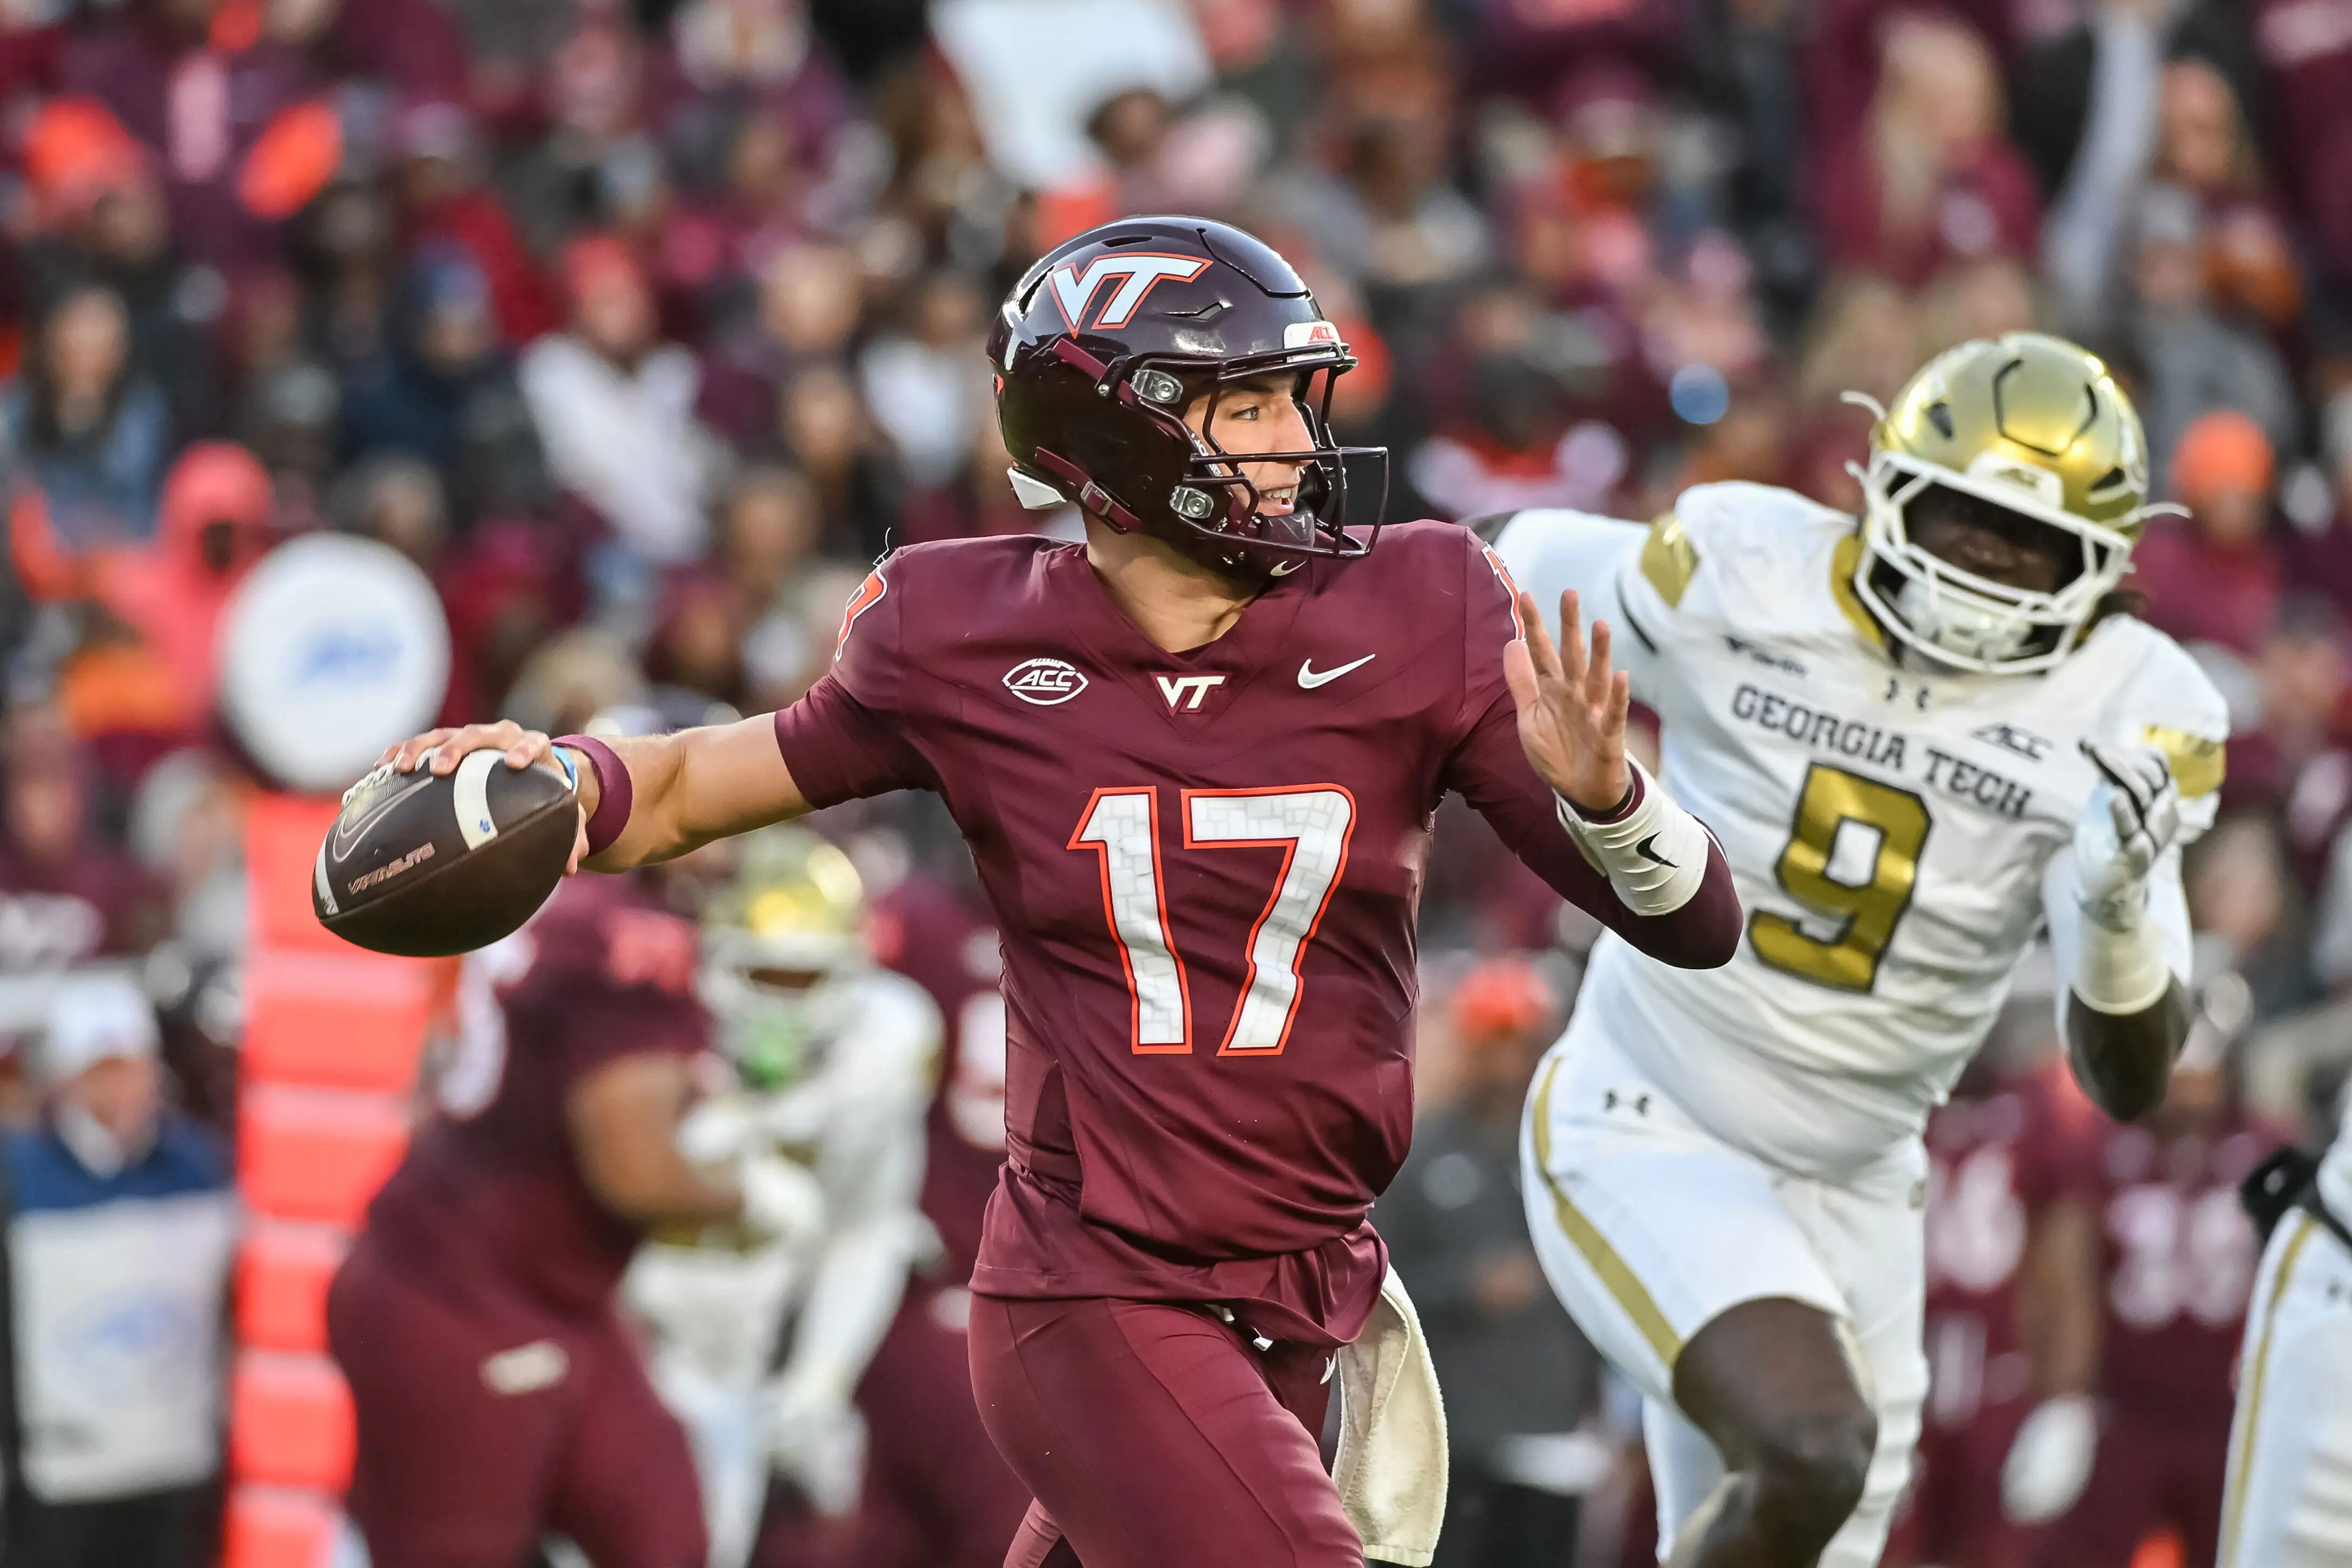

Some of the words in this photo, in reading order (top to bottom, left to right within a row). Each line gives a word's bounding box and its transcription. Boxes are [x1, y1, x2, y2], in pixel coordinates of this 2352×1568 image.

[1049, 252, 1214, 339] VT
[1014, 669, 1076, 687] ACC
[1155, 674, 1227, 711] VT
[1730, 682, 1906, 770] GEORGIA
[1923, 746, 2034, 819] TECH
[1066, 782, 1357, 1056] 17
[1747, 761, 1933, 994] 9
